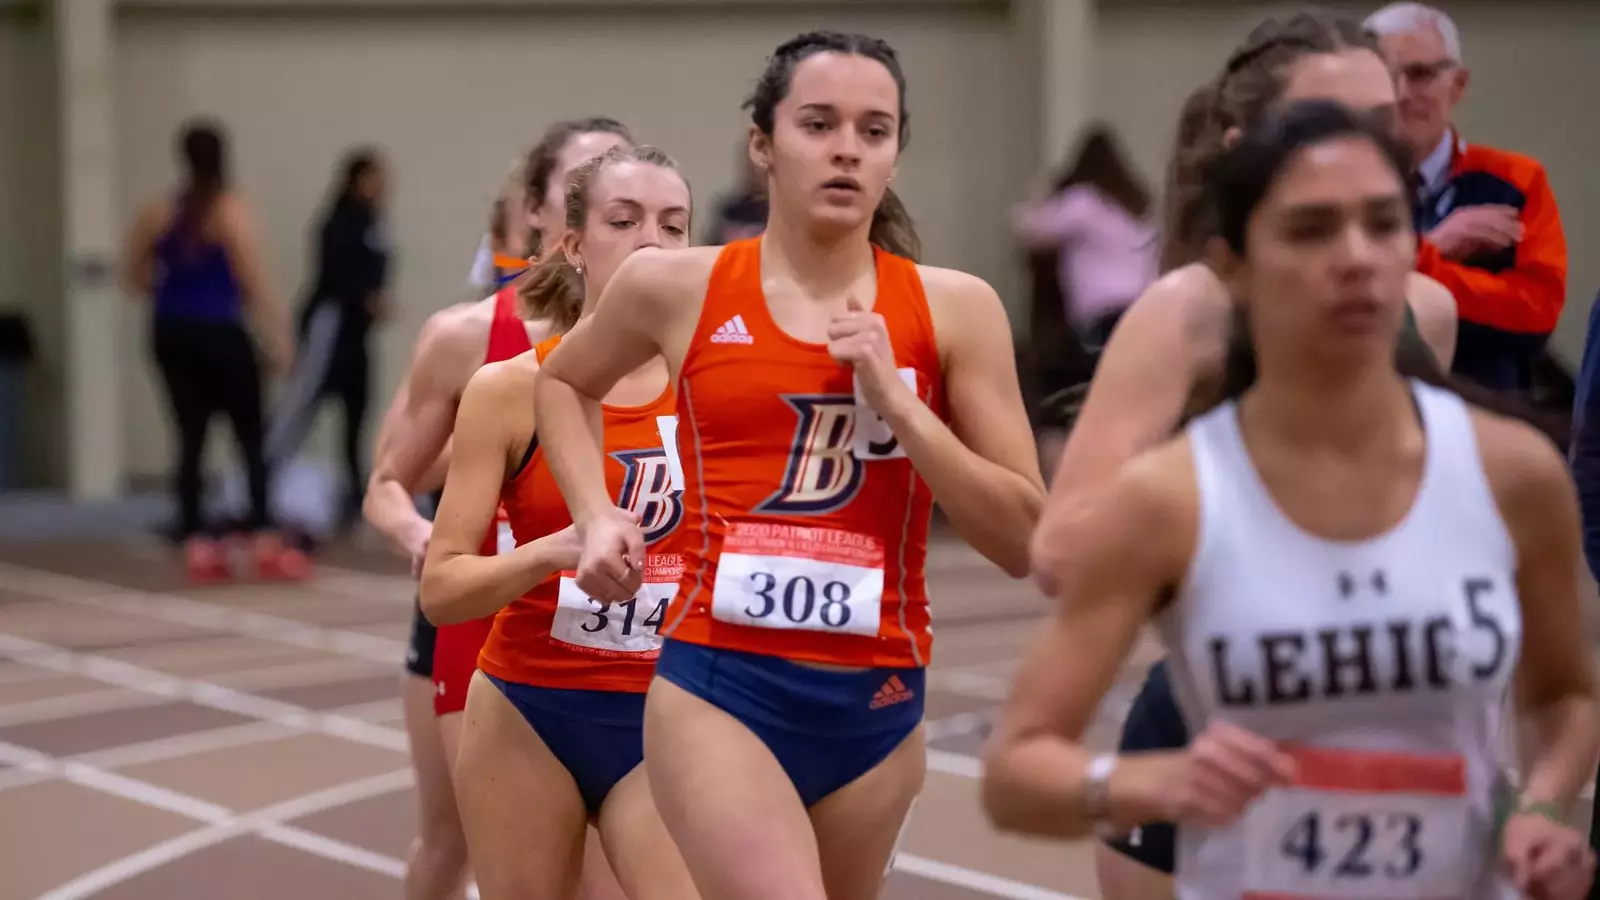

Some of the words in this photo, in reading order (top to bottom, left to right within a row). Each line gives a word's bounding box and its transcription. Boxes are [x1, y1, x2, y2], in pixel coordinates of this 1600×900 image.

[750, 393, 866, 515] B
[607, 446, 685, 545] B
[648, 554, 683, 567] LEAGUE
[735, 522, 769, 537] 2020
[772, 525, 825, 541] PATRIOT
[827, 528, 876, 550] LEAGUE
[581, 597, 669, 635] 314
[744, 571, 852, 627] 308
[1462, 577, 1506, 679] 5
[1280, 810, 1423, 880] 423
